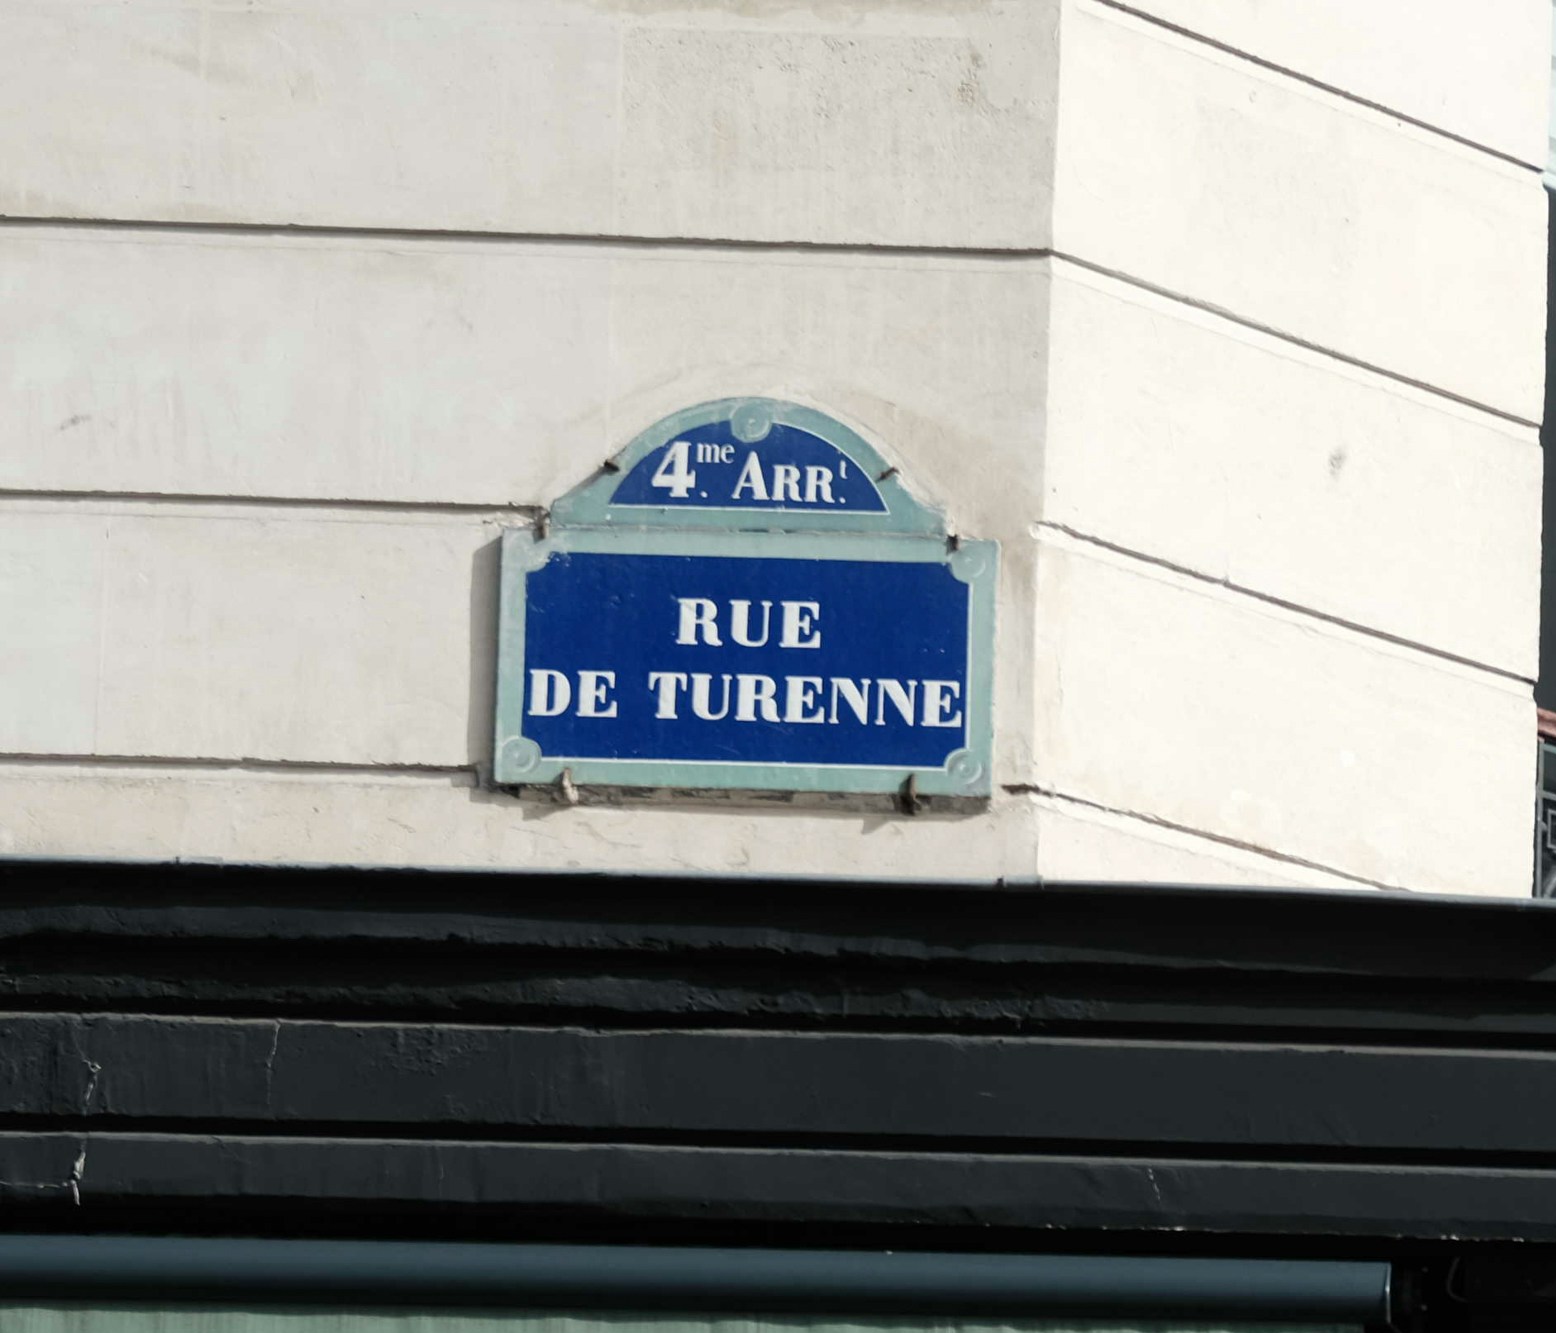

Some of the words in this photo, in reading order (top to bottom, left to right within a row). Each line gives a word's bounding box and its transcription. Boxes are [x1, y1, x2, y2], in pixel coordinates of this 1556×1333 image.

[675, 597, 821, 649] RUE
[528, 668, 618, 718] DE
[648, 671, 963, 728] TURENNE
